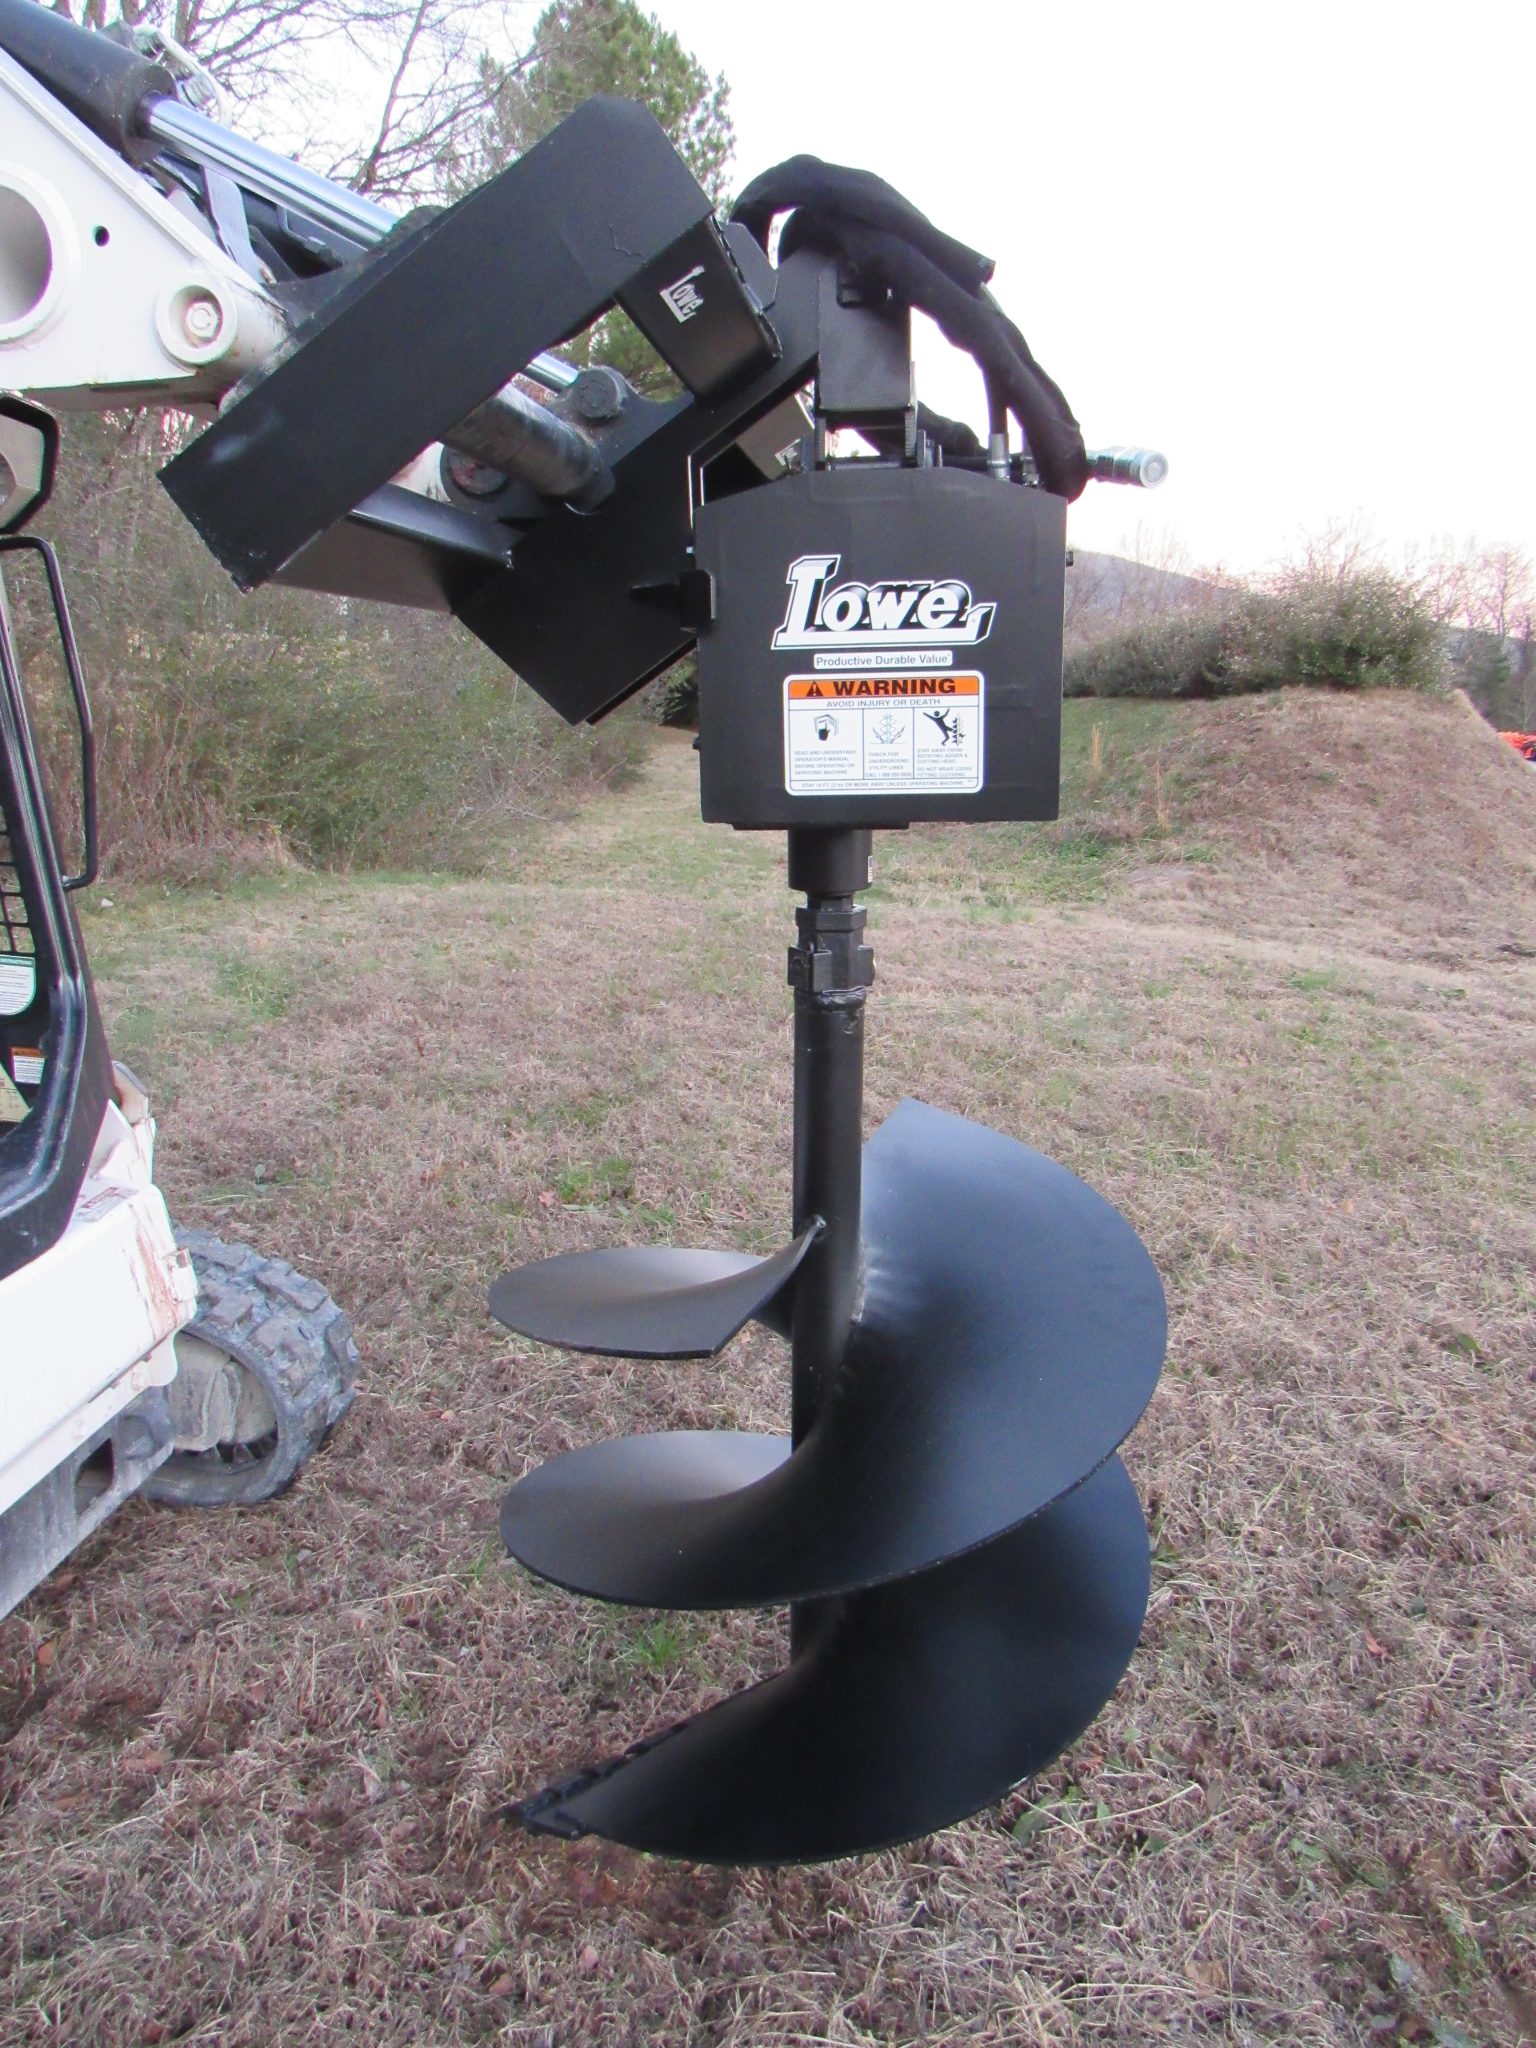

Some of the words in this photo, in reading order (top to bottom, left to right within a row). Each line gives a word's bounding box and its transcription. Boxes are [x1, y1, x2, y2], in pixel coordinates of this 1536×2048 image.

[659, 266, 705, 324] Lowe
[771, 555, 997, 650] Lowe
[815, 656, 872, 667] Productive
[875, 655, 916, 665] Durable
[833, 678, 956, 696] WARNING
[909, 698, 941, 706] DEATH
